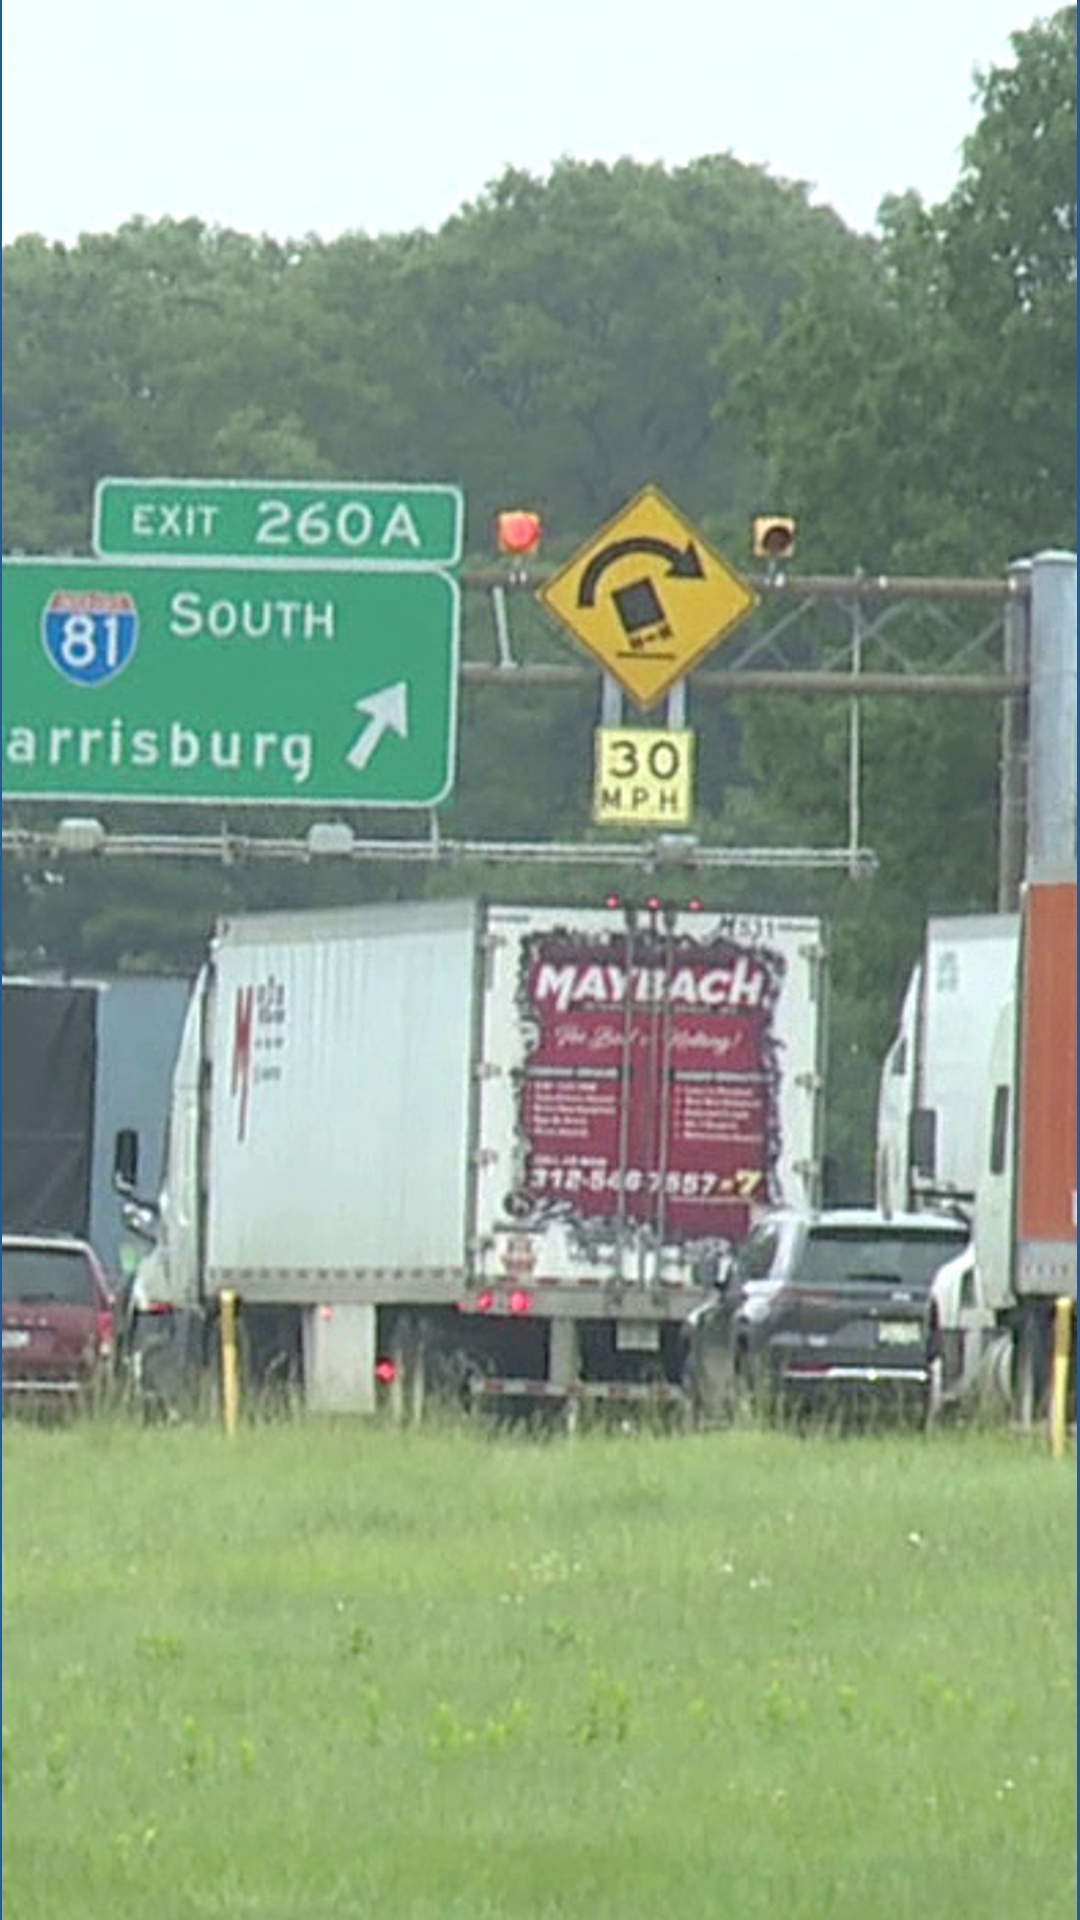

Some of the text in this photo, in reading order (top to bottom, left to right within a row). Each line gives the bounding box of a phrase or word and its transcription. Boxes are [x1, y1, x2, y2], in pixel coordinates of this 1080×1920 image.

[132, 500, 421, 548] EXIT 260A
[61, 591, 336, 668] 81 SOUTH
[6, 719, 313, 782] arrisburg
[608, 740, 681, 780] 30
[601, 786, 679, 814] MPH
[535, 955, 764, 1012] MAYBACH
